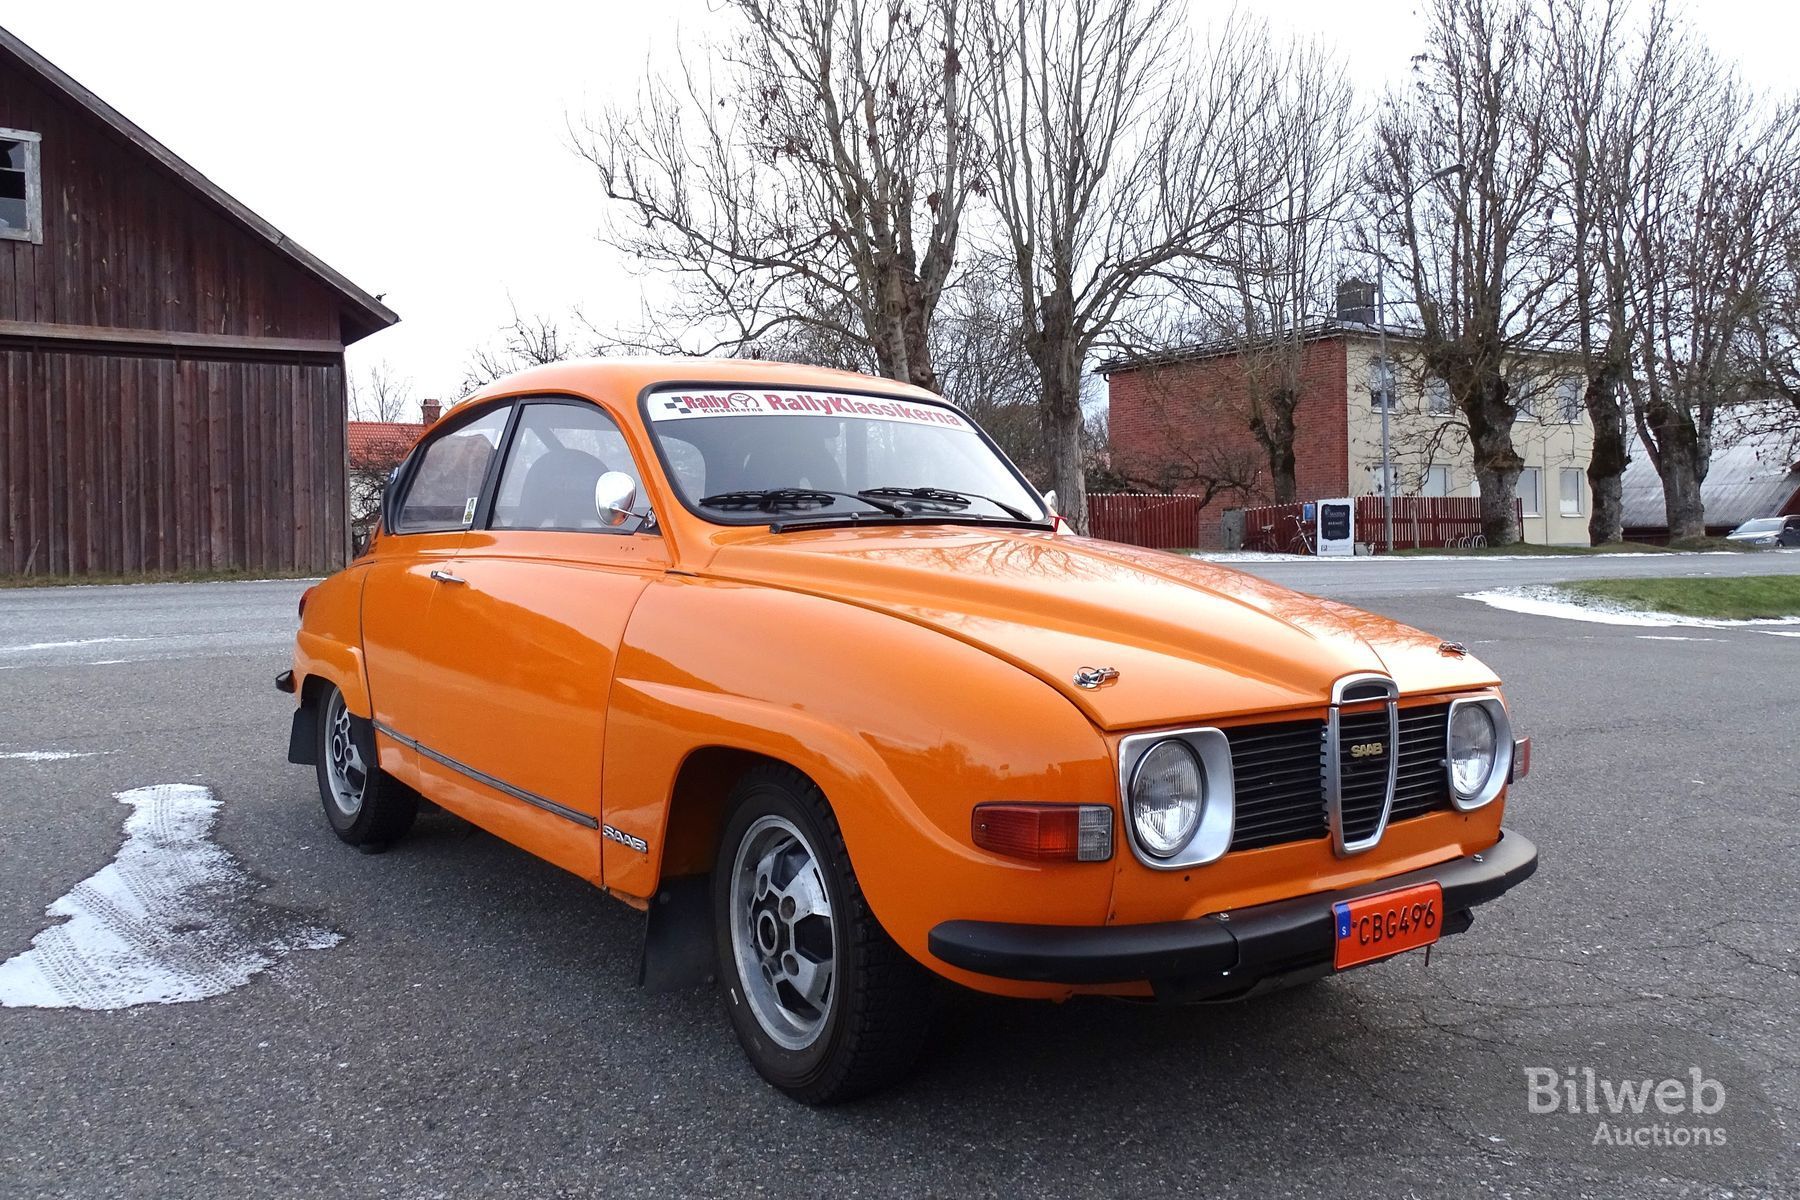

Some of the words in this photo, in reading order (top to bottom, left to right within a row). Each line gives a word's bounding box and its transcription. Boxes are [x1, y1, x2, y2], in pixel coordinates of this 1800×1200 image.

[681, 395, 731, 409] Rally
[763, 394, 963, 427] RallyKlassikerna
[1351, 742, 1383, 758] SAAB
[602, 824, 648, 853] SAAB
[1341, 926, 1347, 936] S
[1359, 899, 1436, 945] CBG496
